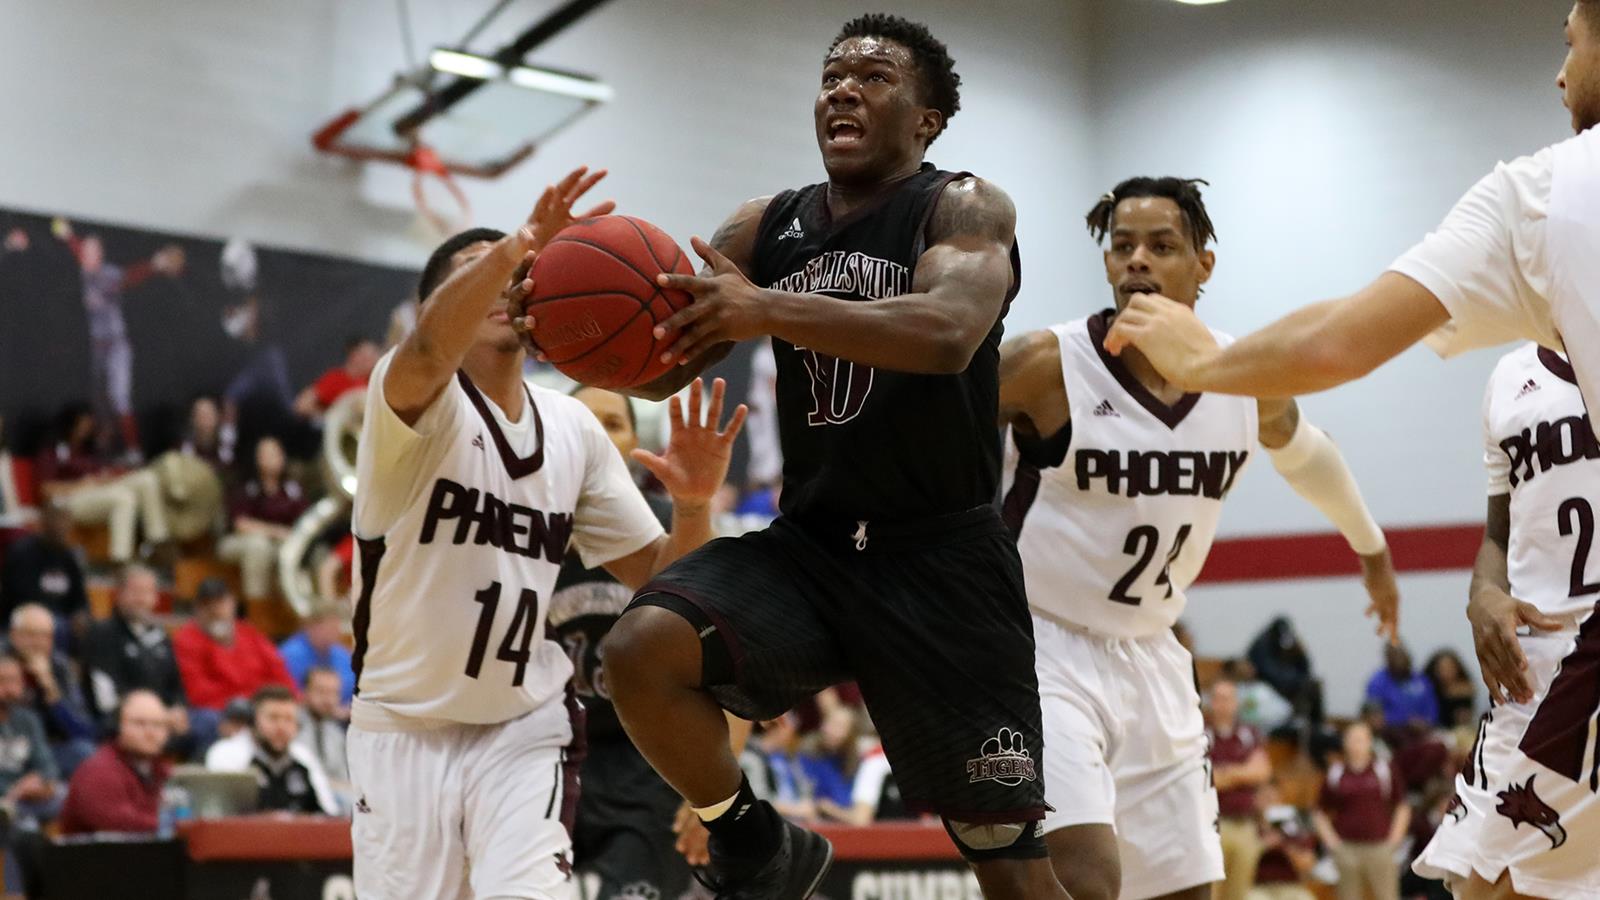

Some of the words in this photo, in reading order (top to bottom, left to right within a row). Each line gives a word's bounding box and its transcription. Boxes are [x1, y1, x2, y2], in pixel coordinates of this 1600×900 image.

[777, 229, 805, 241] adas
[464, 580, 539, 688] 14
[966, 753, 1037, 783] TIGERS
